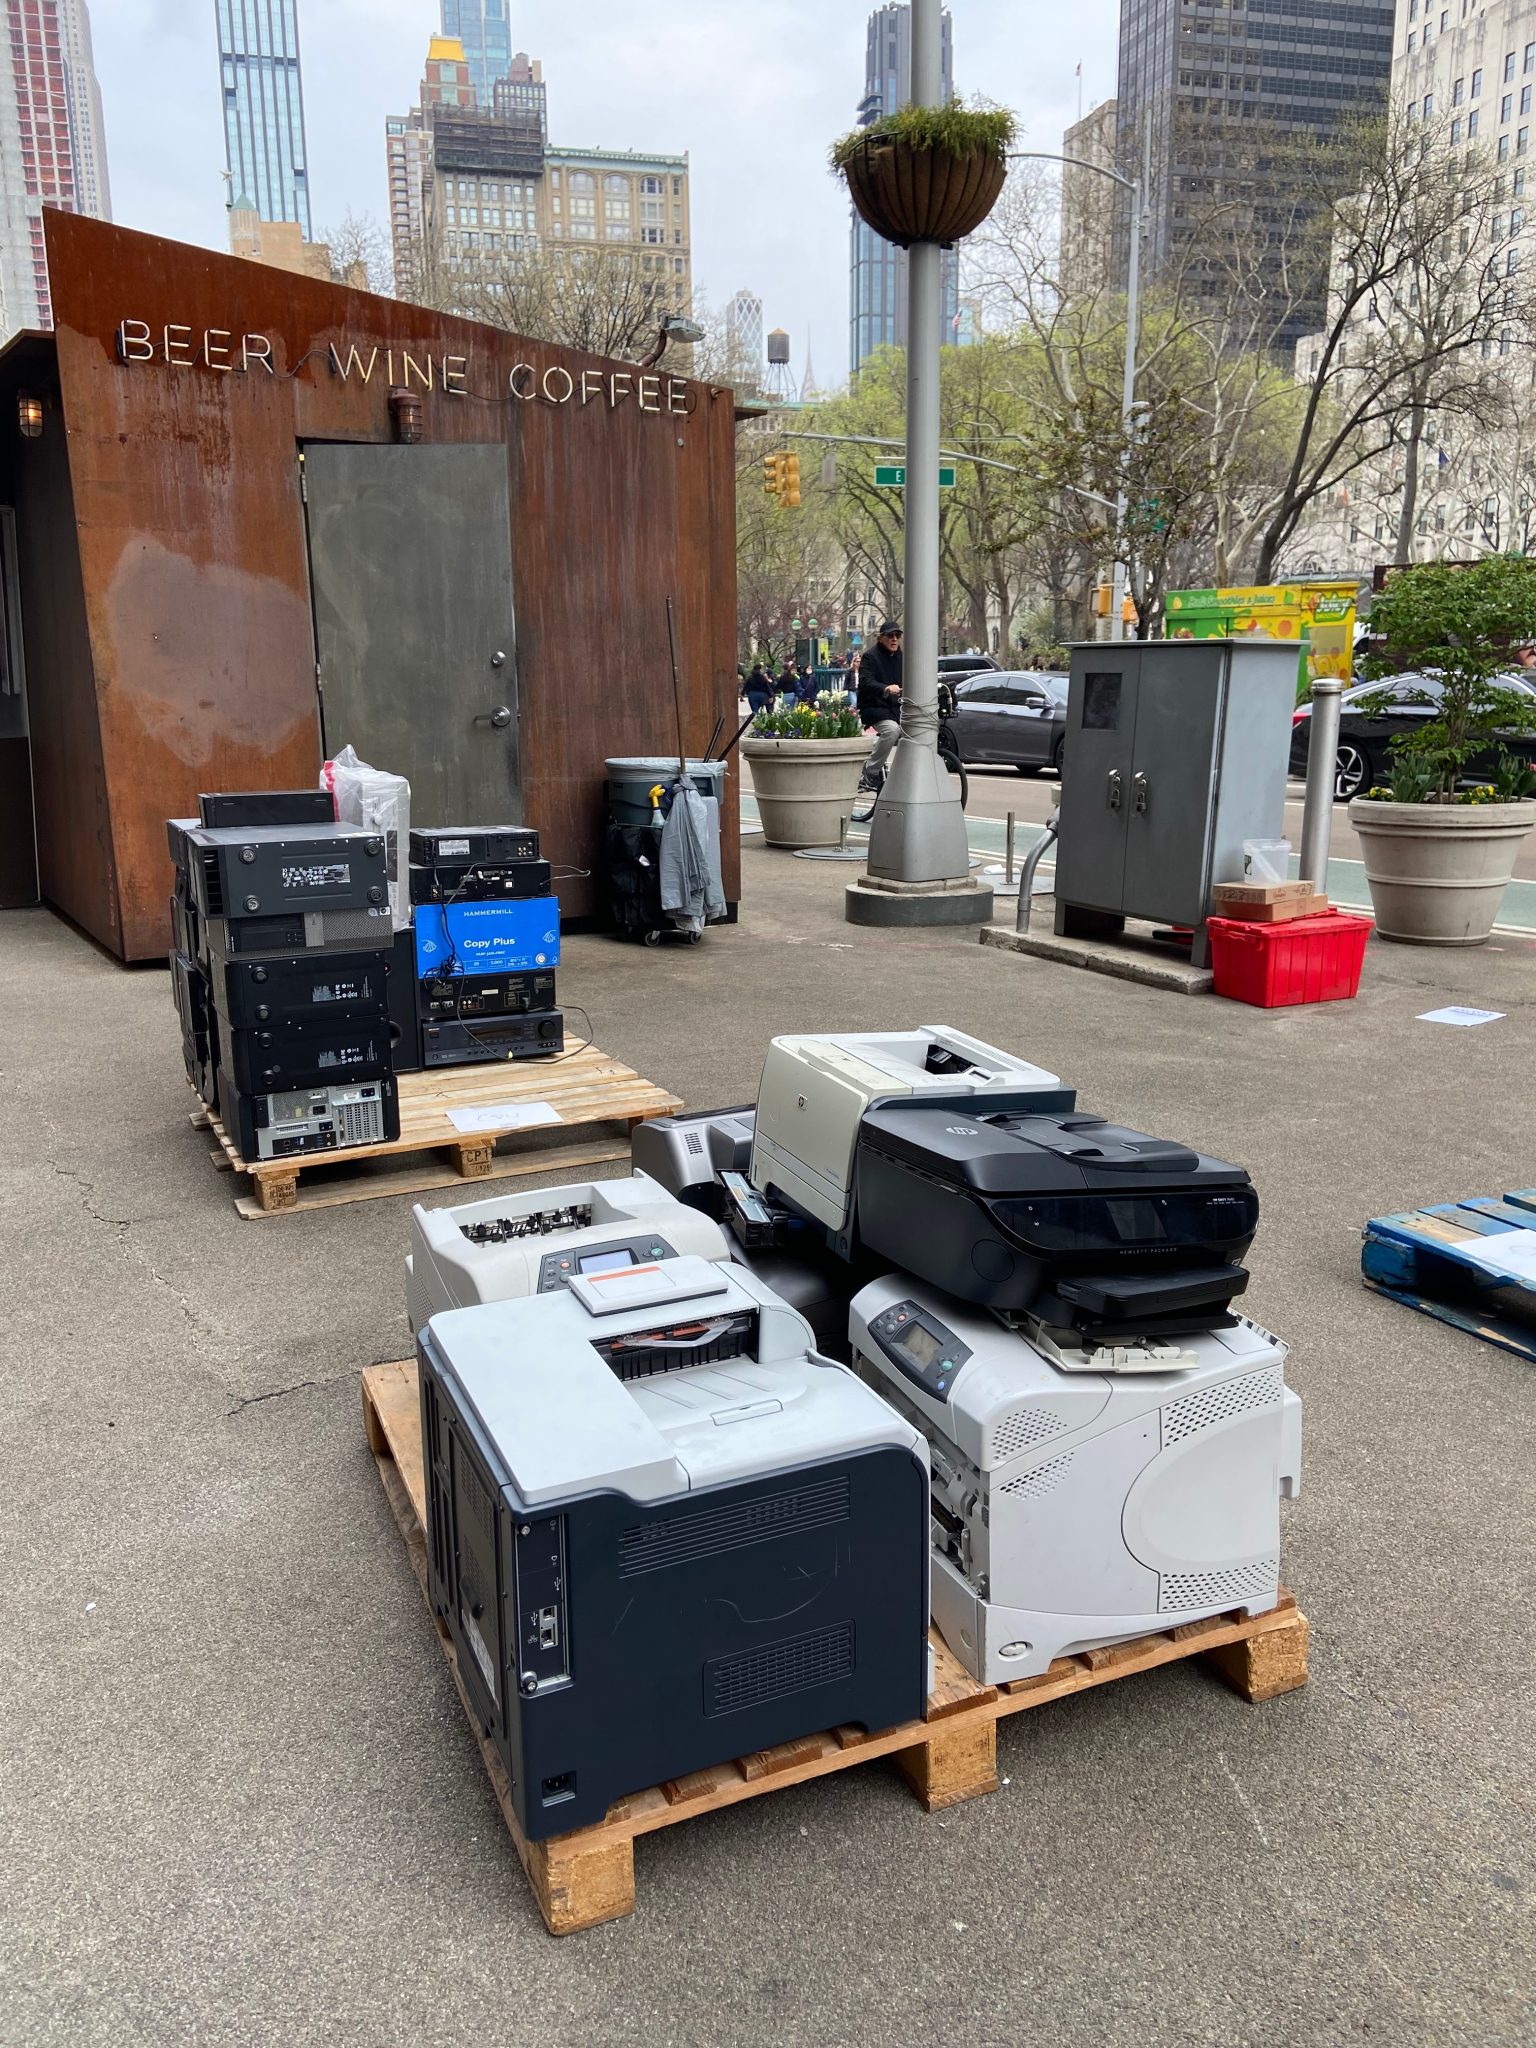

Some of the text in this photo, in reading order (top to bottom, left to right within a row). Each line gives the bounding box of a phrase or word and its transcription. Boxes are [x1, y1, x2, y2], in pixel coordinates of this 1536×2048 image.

[120, 319, 689, 414] BEER WINE COFFEE
[896, 471, 902, 482] E
[463, 909, 514, 917] HAMMERMILL
[463, 936, 516, 950] Copy Plus
